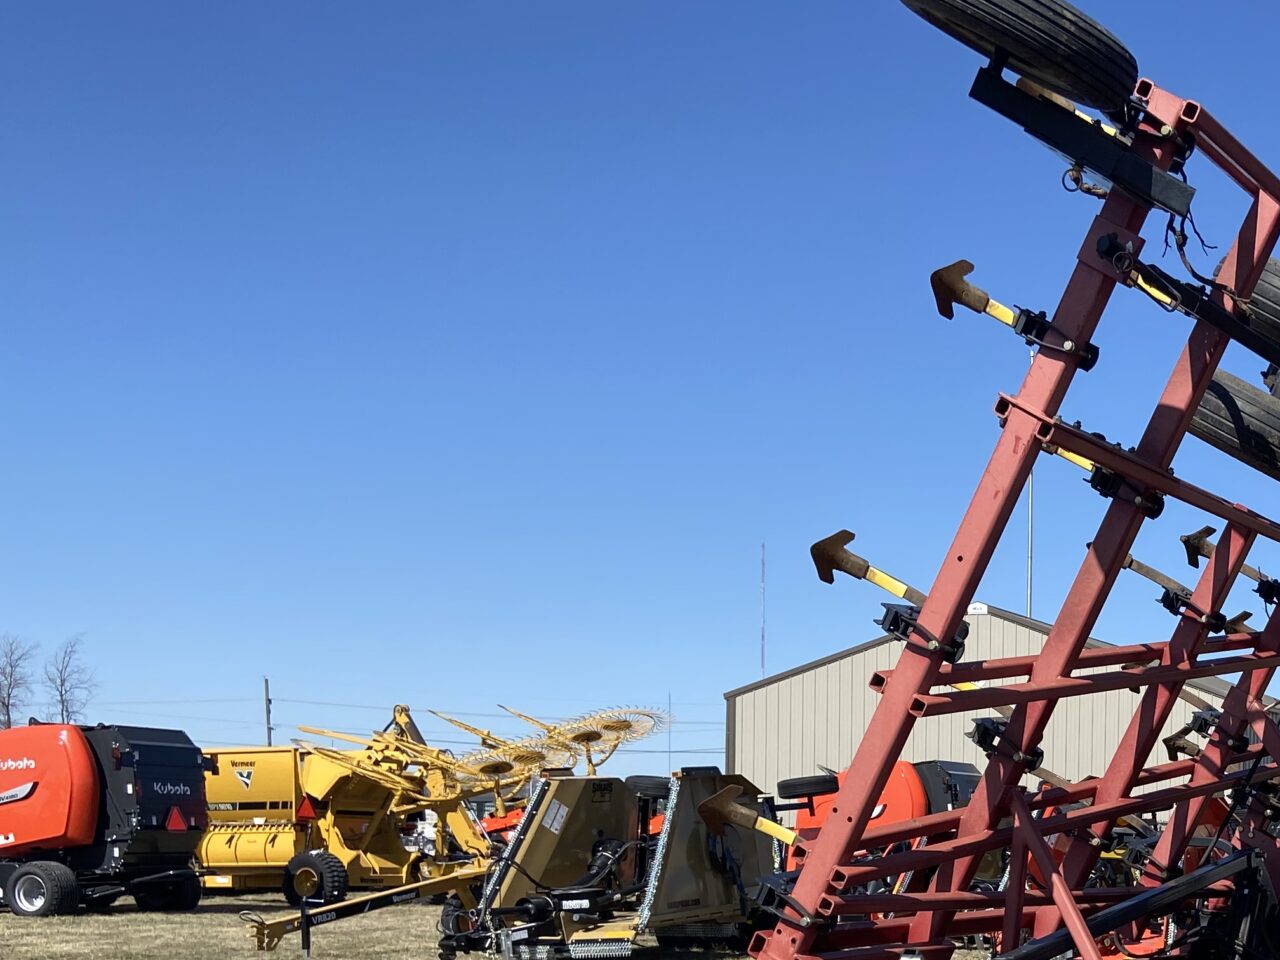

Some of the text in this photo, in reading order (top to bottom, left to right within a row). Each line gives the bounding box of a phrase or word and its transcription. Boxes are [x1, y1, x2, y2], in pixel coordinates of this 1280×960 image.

[0, 757, 36, 771] ubota
[231, 760, 256, 768] Vermeer
[153, 781, 191, 796] Kubota
[312, 911, 336, 925] VR820
